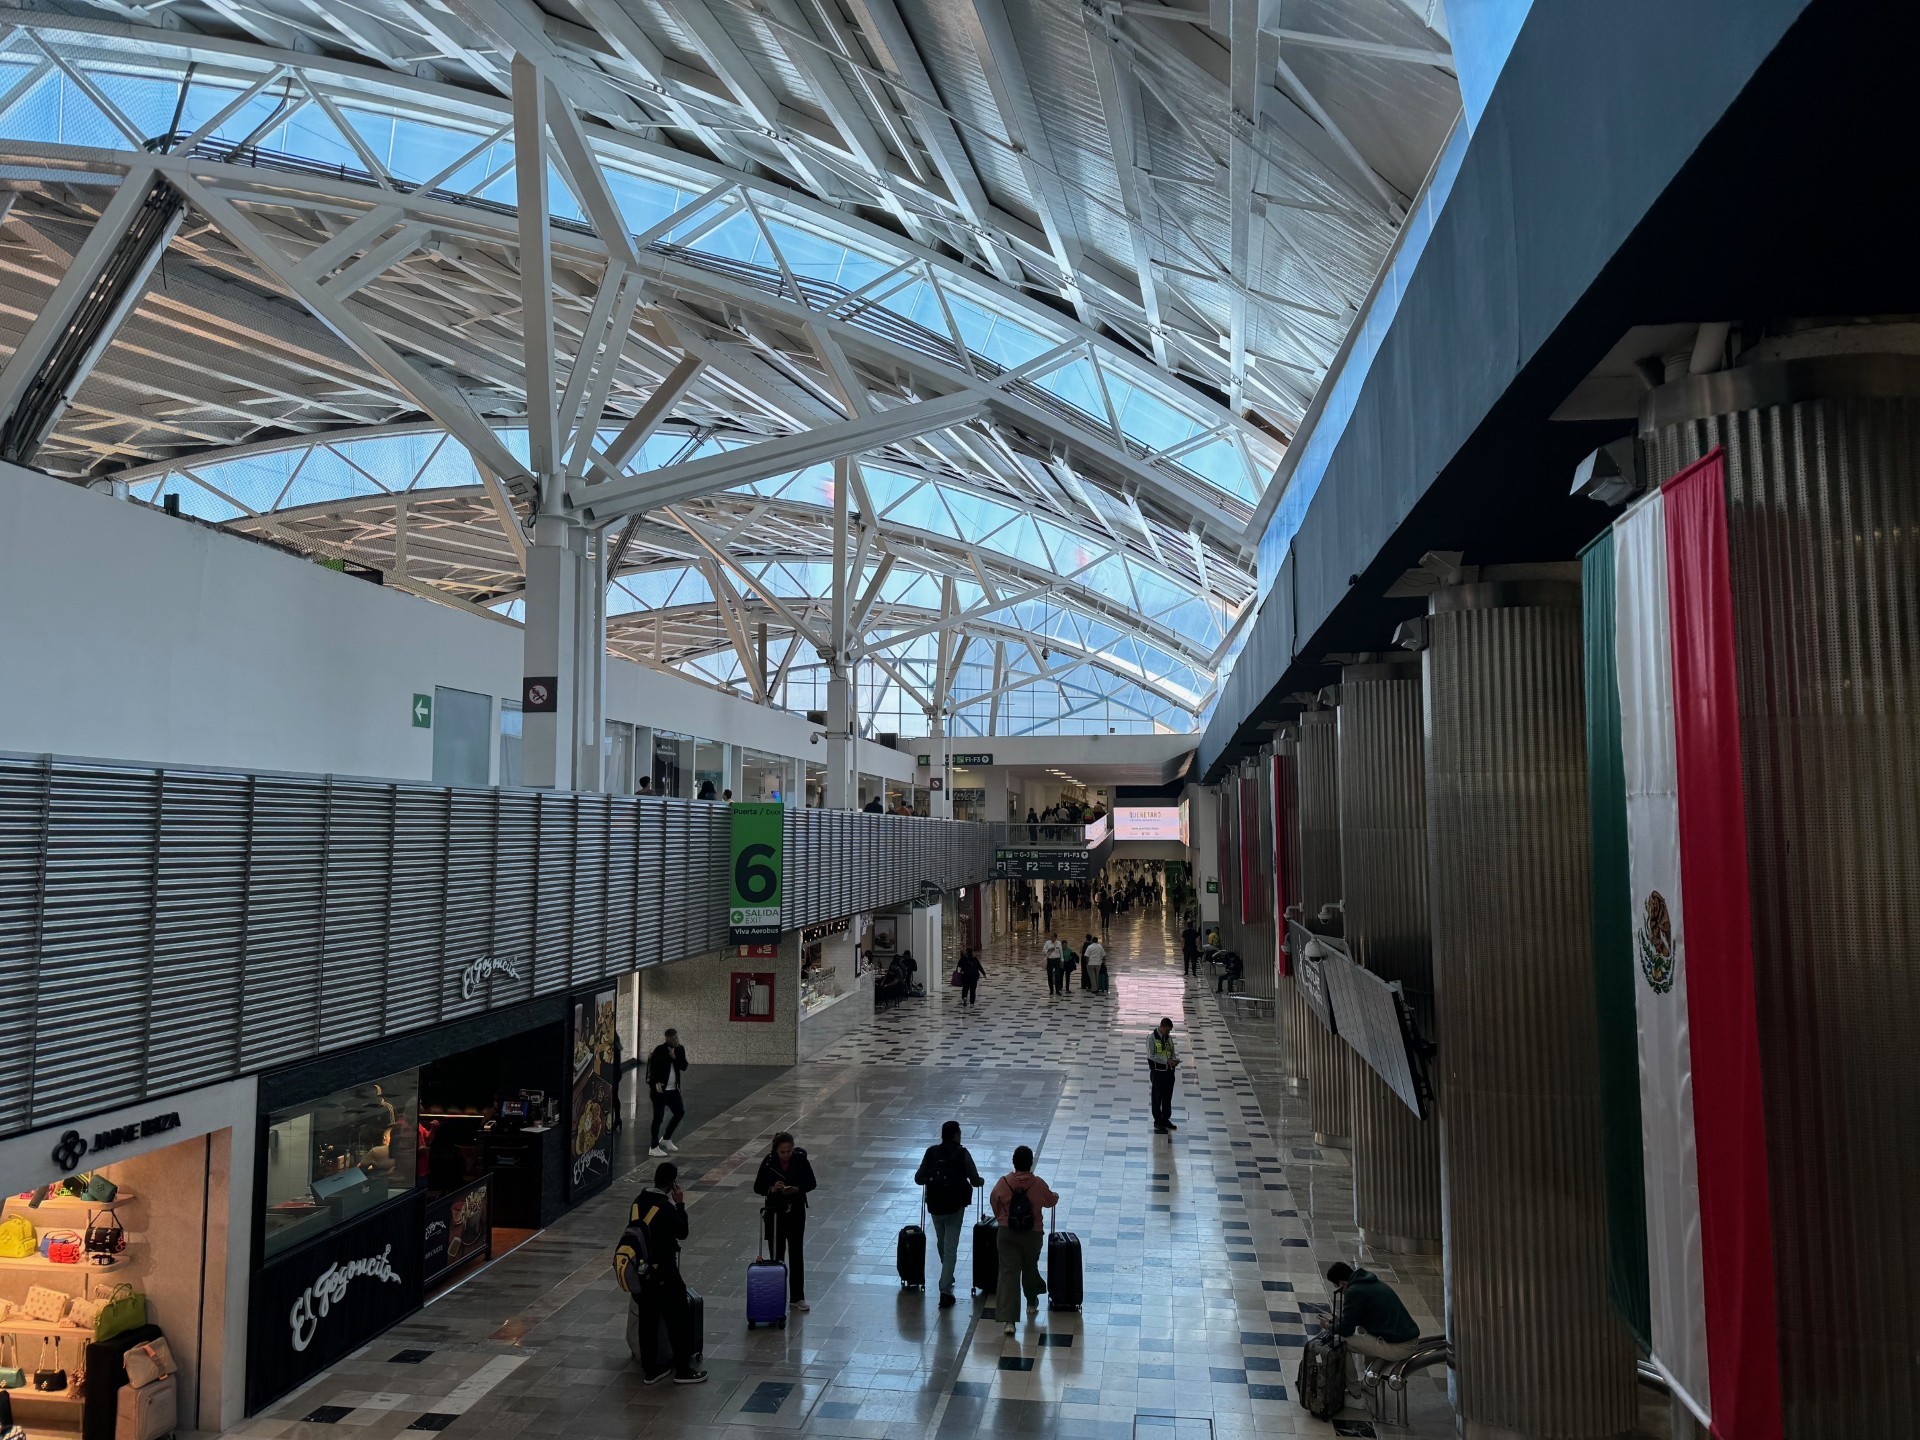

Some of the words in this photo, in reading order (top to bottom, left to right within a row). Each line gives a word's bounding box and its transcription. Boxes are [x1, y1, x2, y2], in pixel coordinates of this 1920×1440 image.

[733, 807, 758, 816] Puerta
[996, 862, 1007, 871] F1
[1026, 862, 1039, 871] F2
[1057, 862, 1070, 871] F3
[734, 843, 777, 903] 6
[745, 909, 779, 918] SALIDA
[745, 917, 763, 925] EXIT
[734, 927, 750, 935] Viva
[750, 927, 779, 935] Aerobus
[462, 966, 476, 1000] El
[289, 1287, 318, 1352] El
